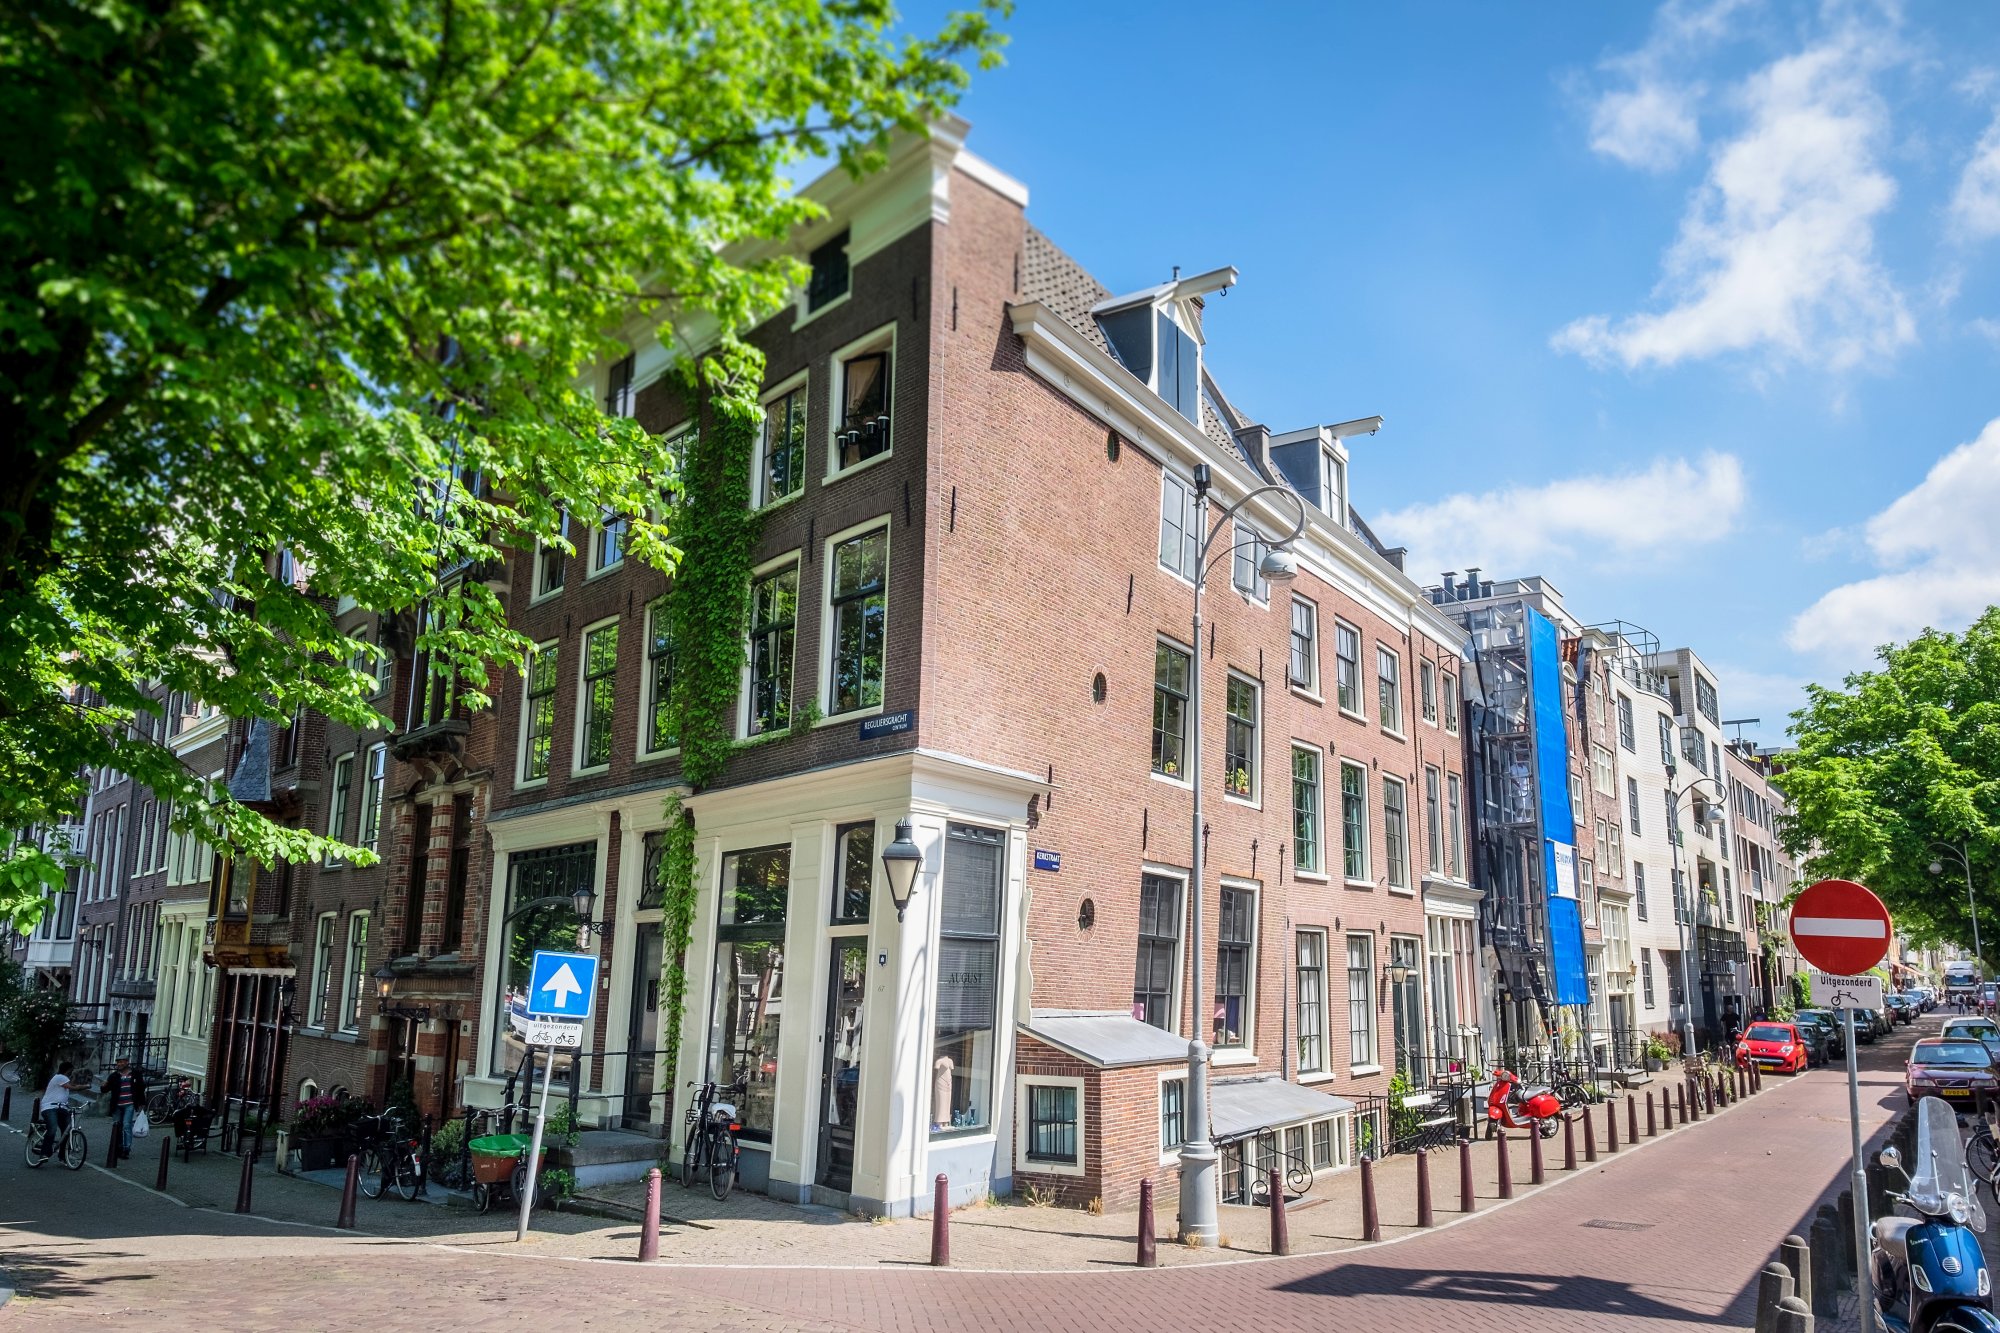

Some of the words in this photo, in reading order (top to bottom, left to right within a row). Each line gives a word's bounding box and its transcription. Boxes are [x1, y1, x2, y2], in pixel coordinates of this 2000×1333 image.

[864, 713, 908, 730] REGULIERSGRACHT
[948, 972, 982, 984] AUGUST
[1820, 975, 1872, 988] Uitgezonderd
[533, 1022, 578, 1031] uitgezonderd
